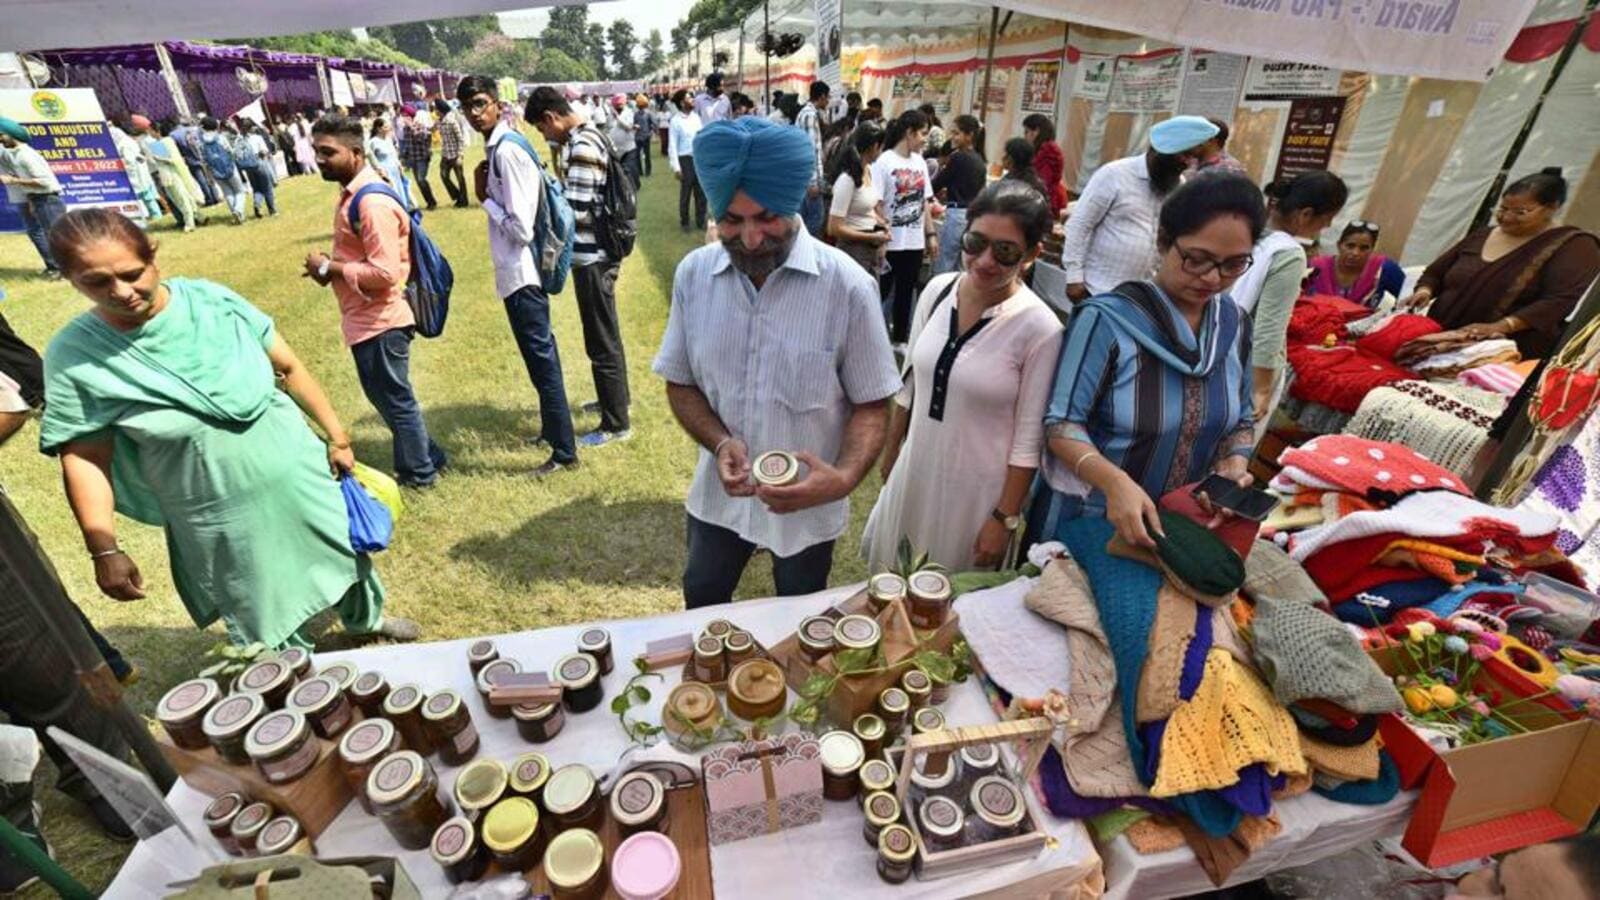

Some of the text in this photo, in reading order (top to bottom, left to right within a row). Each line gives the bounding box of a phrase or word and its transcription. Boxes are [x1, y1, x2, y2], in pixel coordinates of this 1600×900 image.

[48, 124, 103, 136] INDUSTRY
[54, 136, 78, 148] AND
[74, 148, 106, 159] MELA
